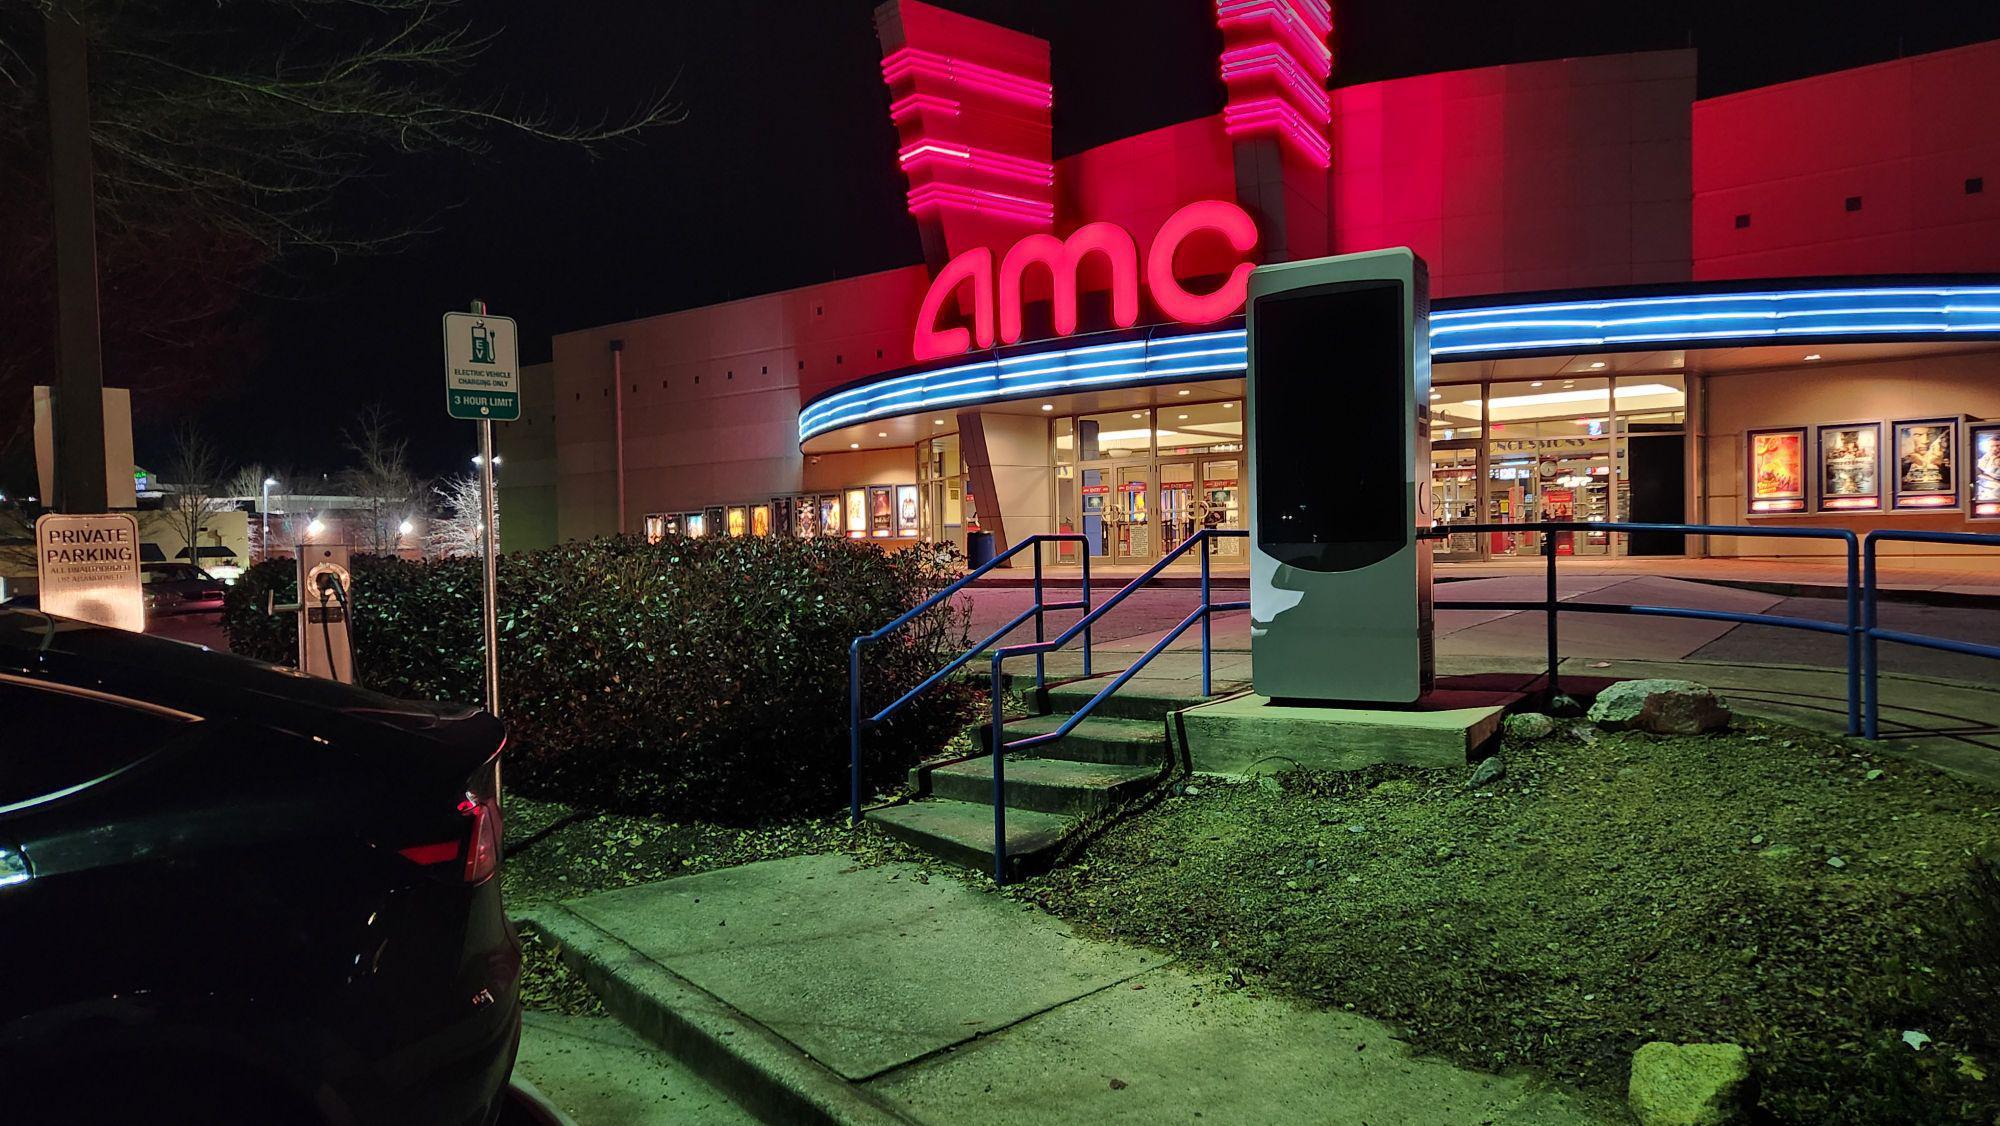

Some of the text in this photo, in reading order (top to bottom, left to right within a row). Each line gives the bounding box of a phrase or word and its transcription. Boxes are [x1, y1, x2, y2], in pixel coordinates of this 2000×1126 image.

[454, 369, 511, 378] ELECTRIC VEHICLE
[458, 378, 491, 386] CHARGING
[454, 395, 513, 407] 3 HOUR LIMIT
[49, 528, 128, 543] PRIVATE
[47, 547, 132, 563] PARKING
